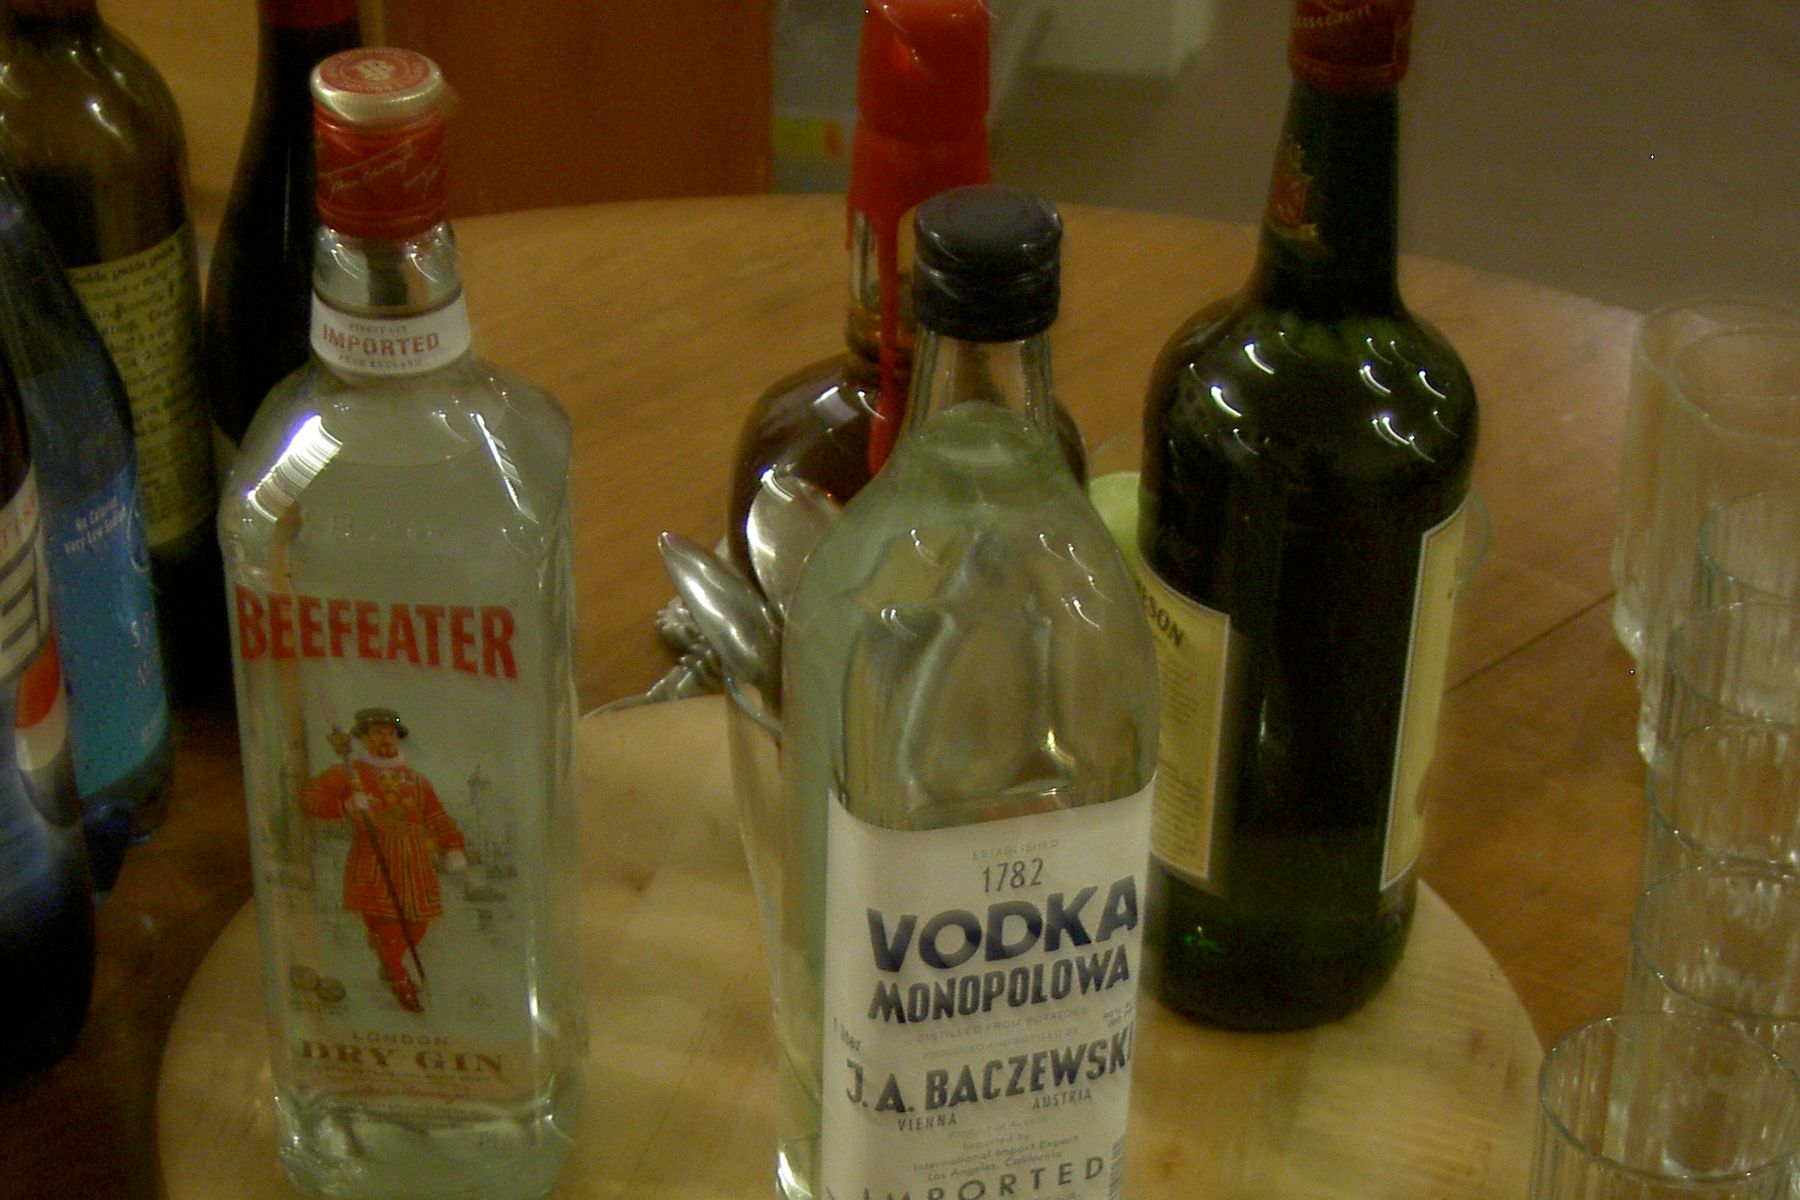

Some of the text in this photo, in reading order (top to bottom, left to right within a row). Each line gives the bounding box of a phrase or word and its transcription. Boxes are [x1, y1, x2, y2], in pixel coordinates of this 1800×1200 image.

[322, 322, 440, 356] IMPORTED
[234, 584, 518, 682] BEEFEATER
[982, 857, 1044, 893] 1782
[866, 874, 1139, 973] VODKA
[867, 944, 1129, 1024] MONOPOLOWA
[351, 1030, 448, 1047] LONDON
[300, 1039, 398, 1067] DRY
[415, 1050, 505, 1078] GIN
[1031, 1087, 1092, 1111] AUSTRIA
[897, 1113, 957, 1132] VIENNA
